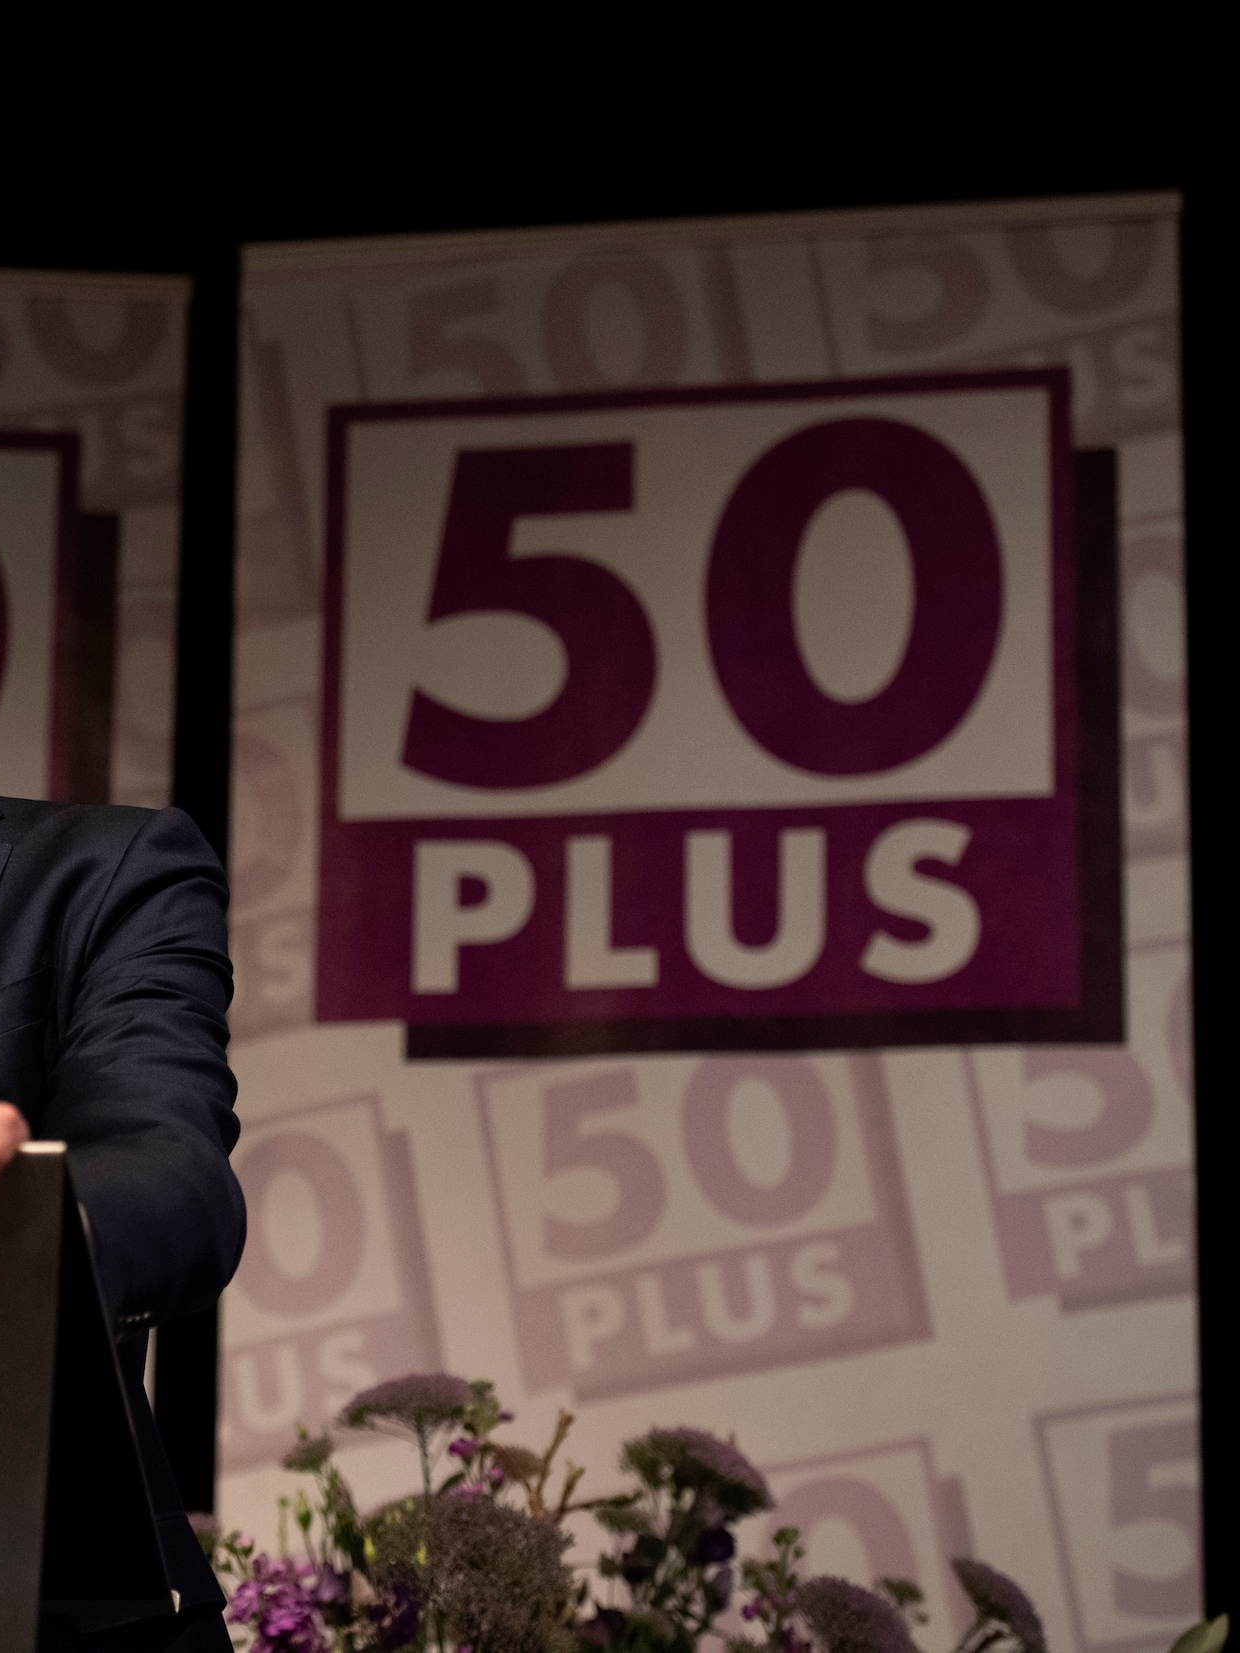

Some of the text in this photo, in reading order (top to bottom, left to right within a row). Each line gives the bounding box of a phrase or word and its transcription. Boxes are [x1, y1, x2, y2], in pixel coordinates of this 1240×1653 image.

[399, 416, 1006, 792] 50
[411, 817, 982, 996] PLUS
[542, 1054, 836, 1260] 50
[1048, 1182, 1190, 1282] PL
[562, 1244, 854, 1370] PLUS
